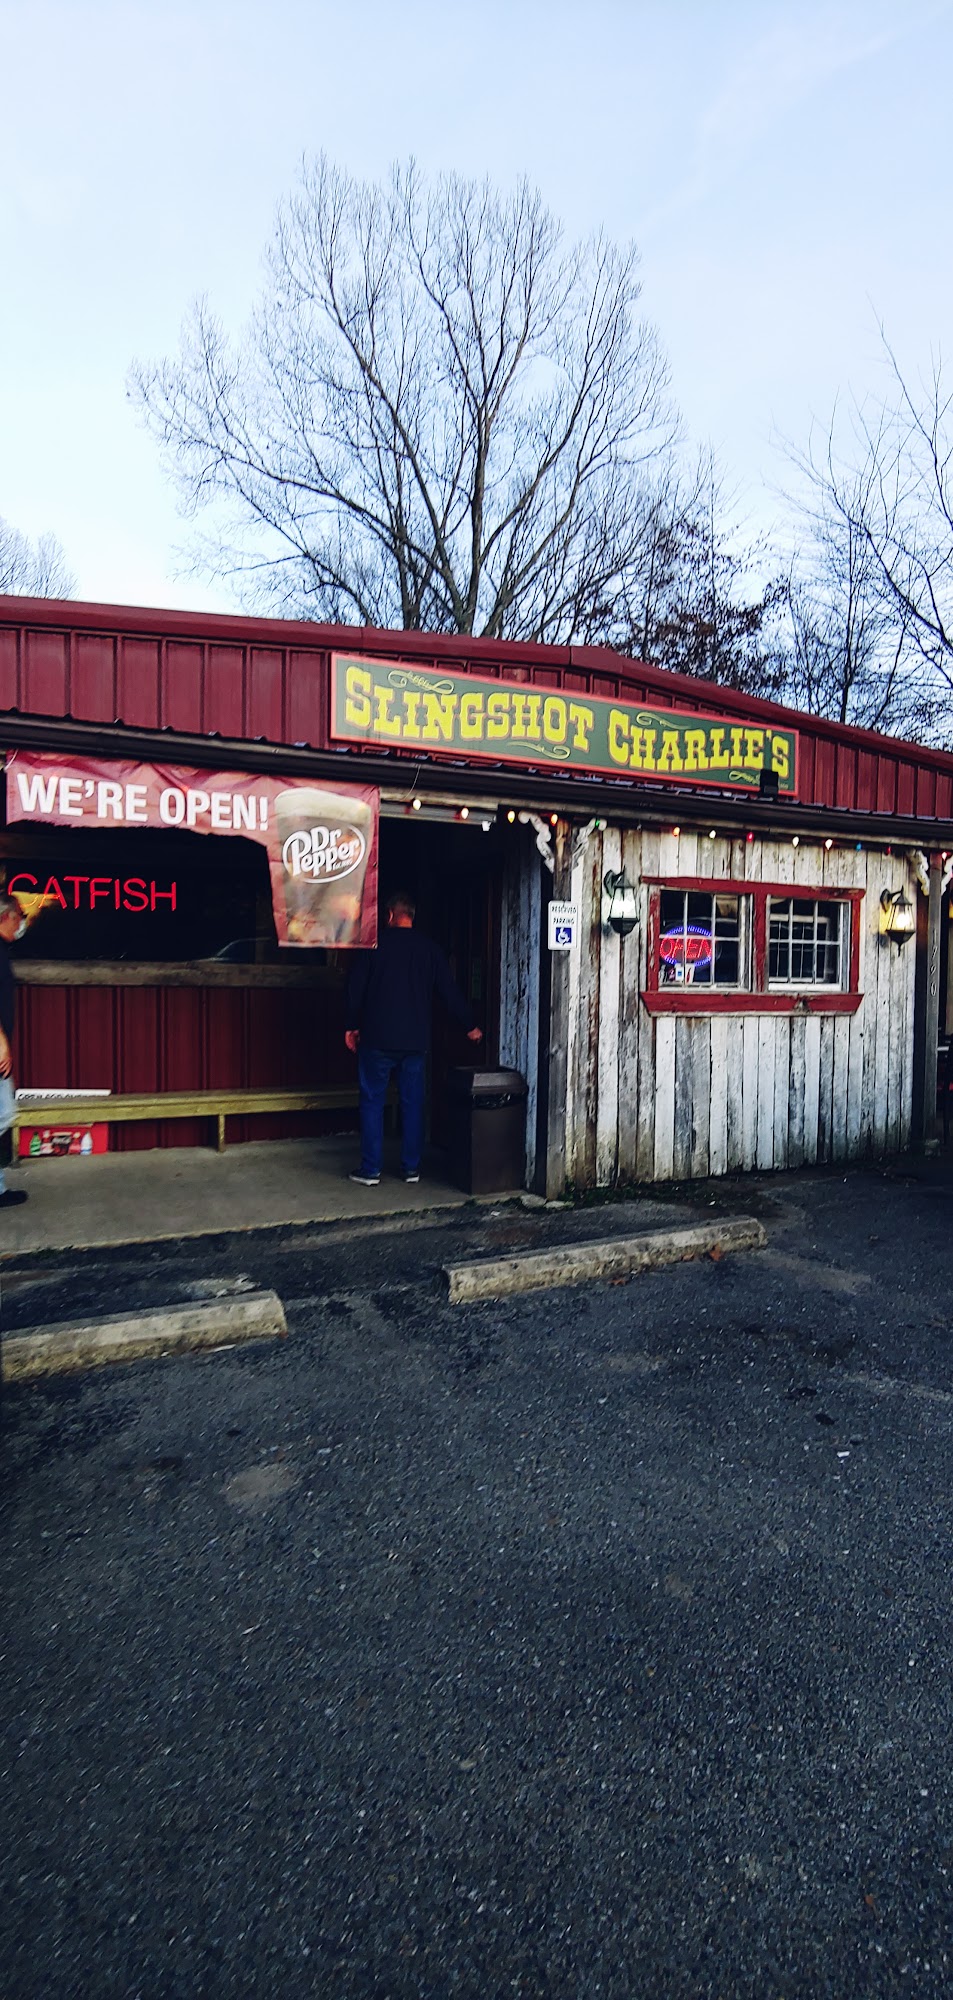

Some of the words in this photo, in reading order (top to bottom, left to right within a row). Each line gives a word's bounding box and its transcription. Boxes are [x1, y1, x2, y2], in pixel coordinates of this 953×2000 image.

[345, 665, 596, 752] SLINGSHOT
[607, 708, 790, 779] CHARLIE'S
[16, 772, 150, 823] WE'RE
[159, 786, 269, 831] OPEN!
[285, 831, 360, 877] Pepper
[310, 825, 342, 853] Dr
[8, 873, 177, 912] CATFISH
[551, 905, 577, 914] RESERVED
[553, 917, 575, 925] PARKING
[660, 936, 712, 959] OPEN
